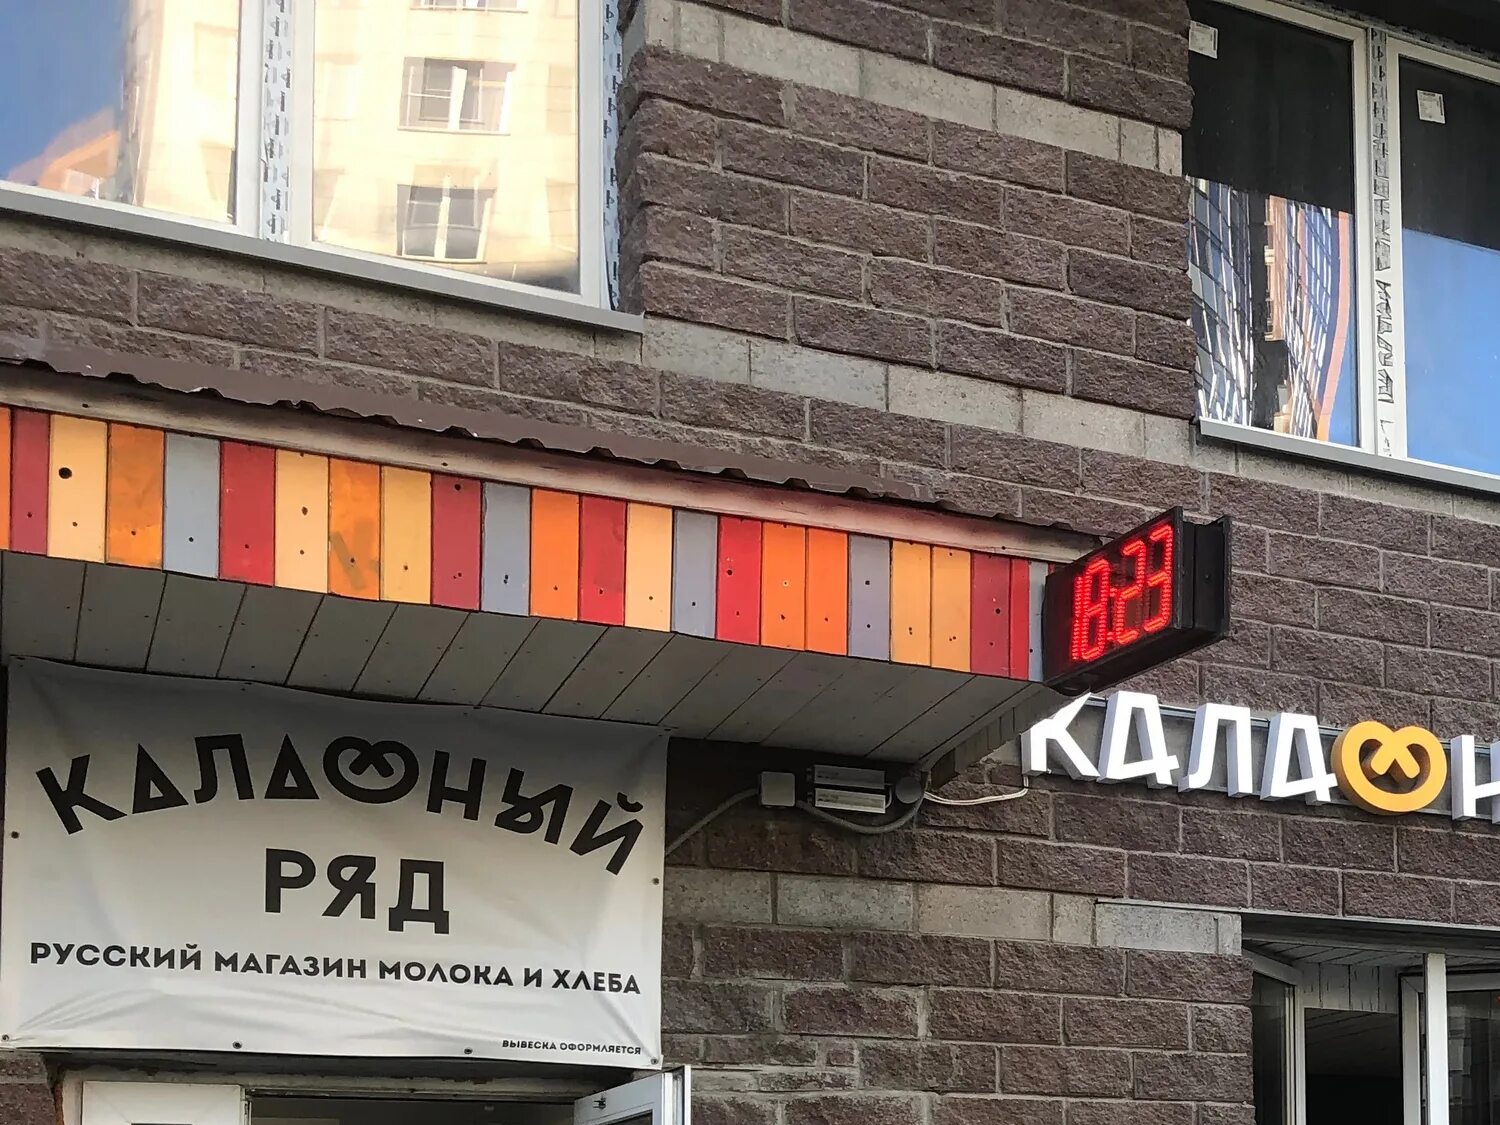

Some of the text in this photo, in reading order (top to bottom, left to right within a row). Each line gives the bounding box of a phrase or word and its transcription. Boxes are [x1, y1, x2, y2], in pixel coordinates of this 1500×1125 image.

[264, 847, 450, 935] РЯД
[30, 942, 641, 995] РУССКИЙ МАГАЗИН МОЛОКА И ХЛЕБА
[502, 1039, 642, 1055] ВЫВЕСКА ОФОРМЛЯЕТСЯ
